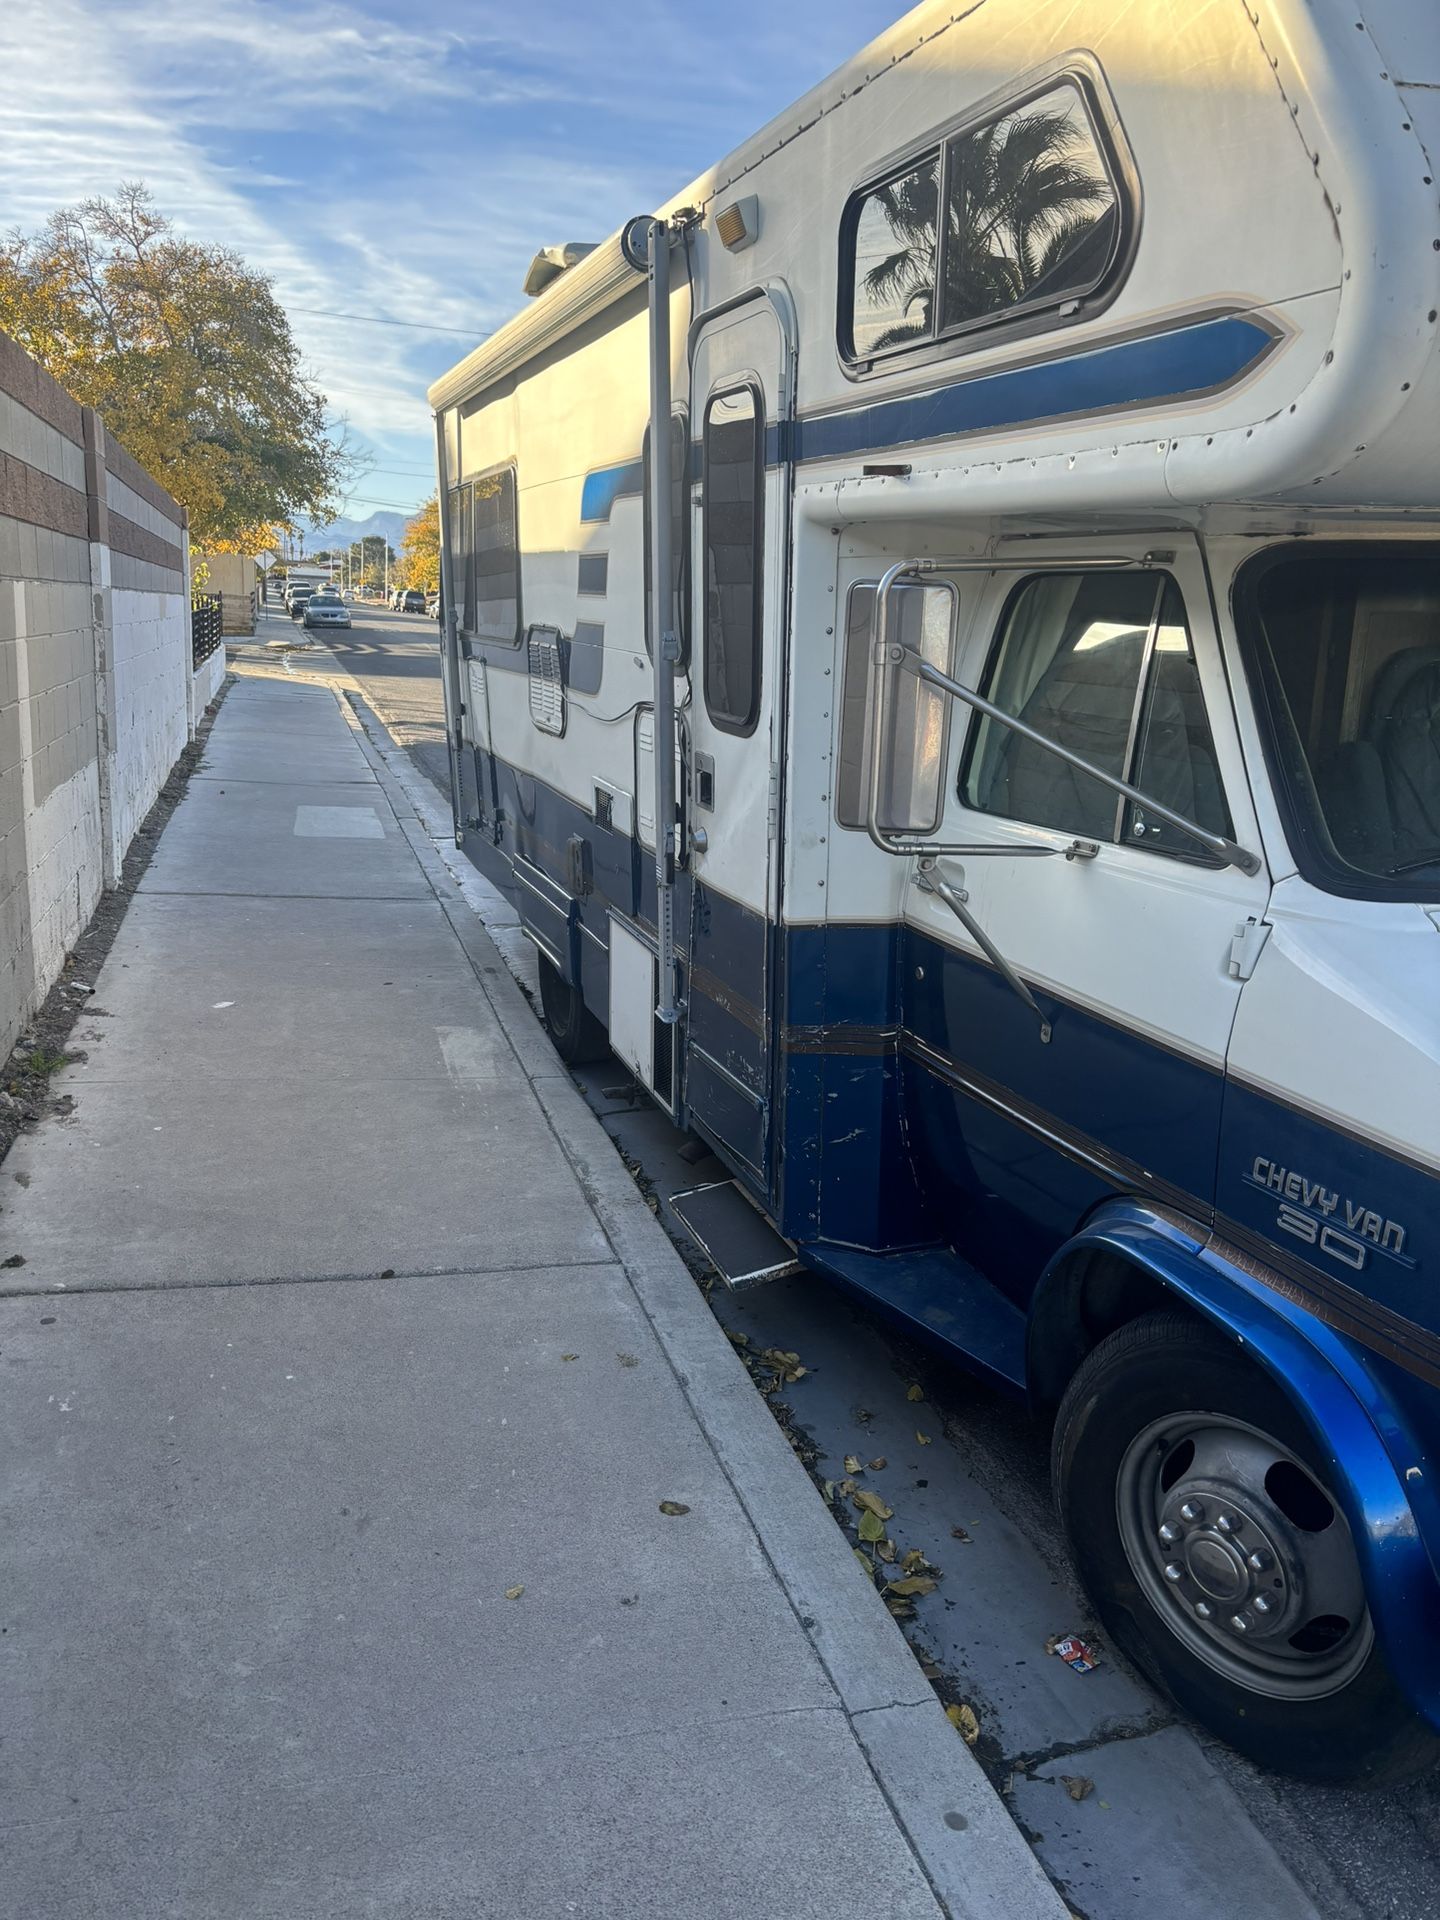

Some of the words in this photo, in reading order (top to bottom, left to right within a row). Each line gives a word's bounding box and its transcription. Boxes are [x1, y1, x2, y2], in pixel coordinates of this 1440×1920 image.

[1252, 1156, 1339, 1217] CHEVY
[1345, 1200, 1405, 1254] VAN
[1276, 1203, 1366, 1270] 30
